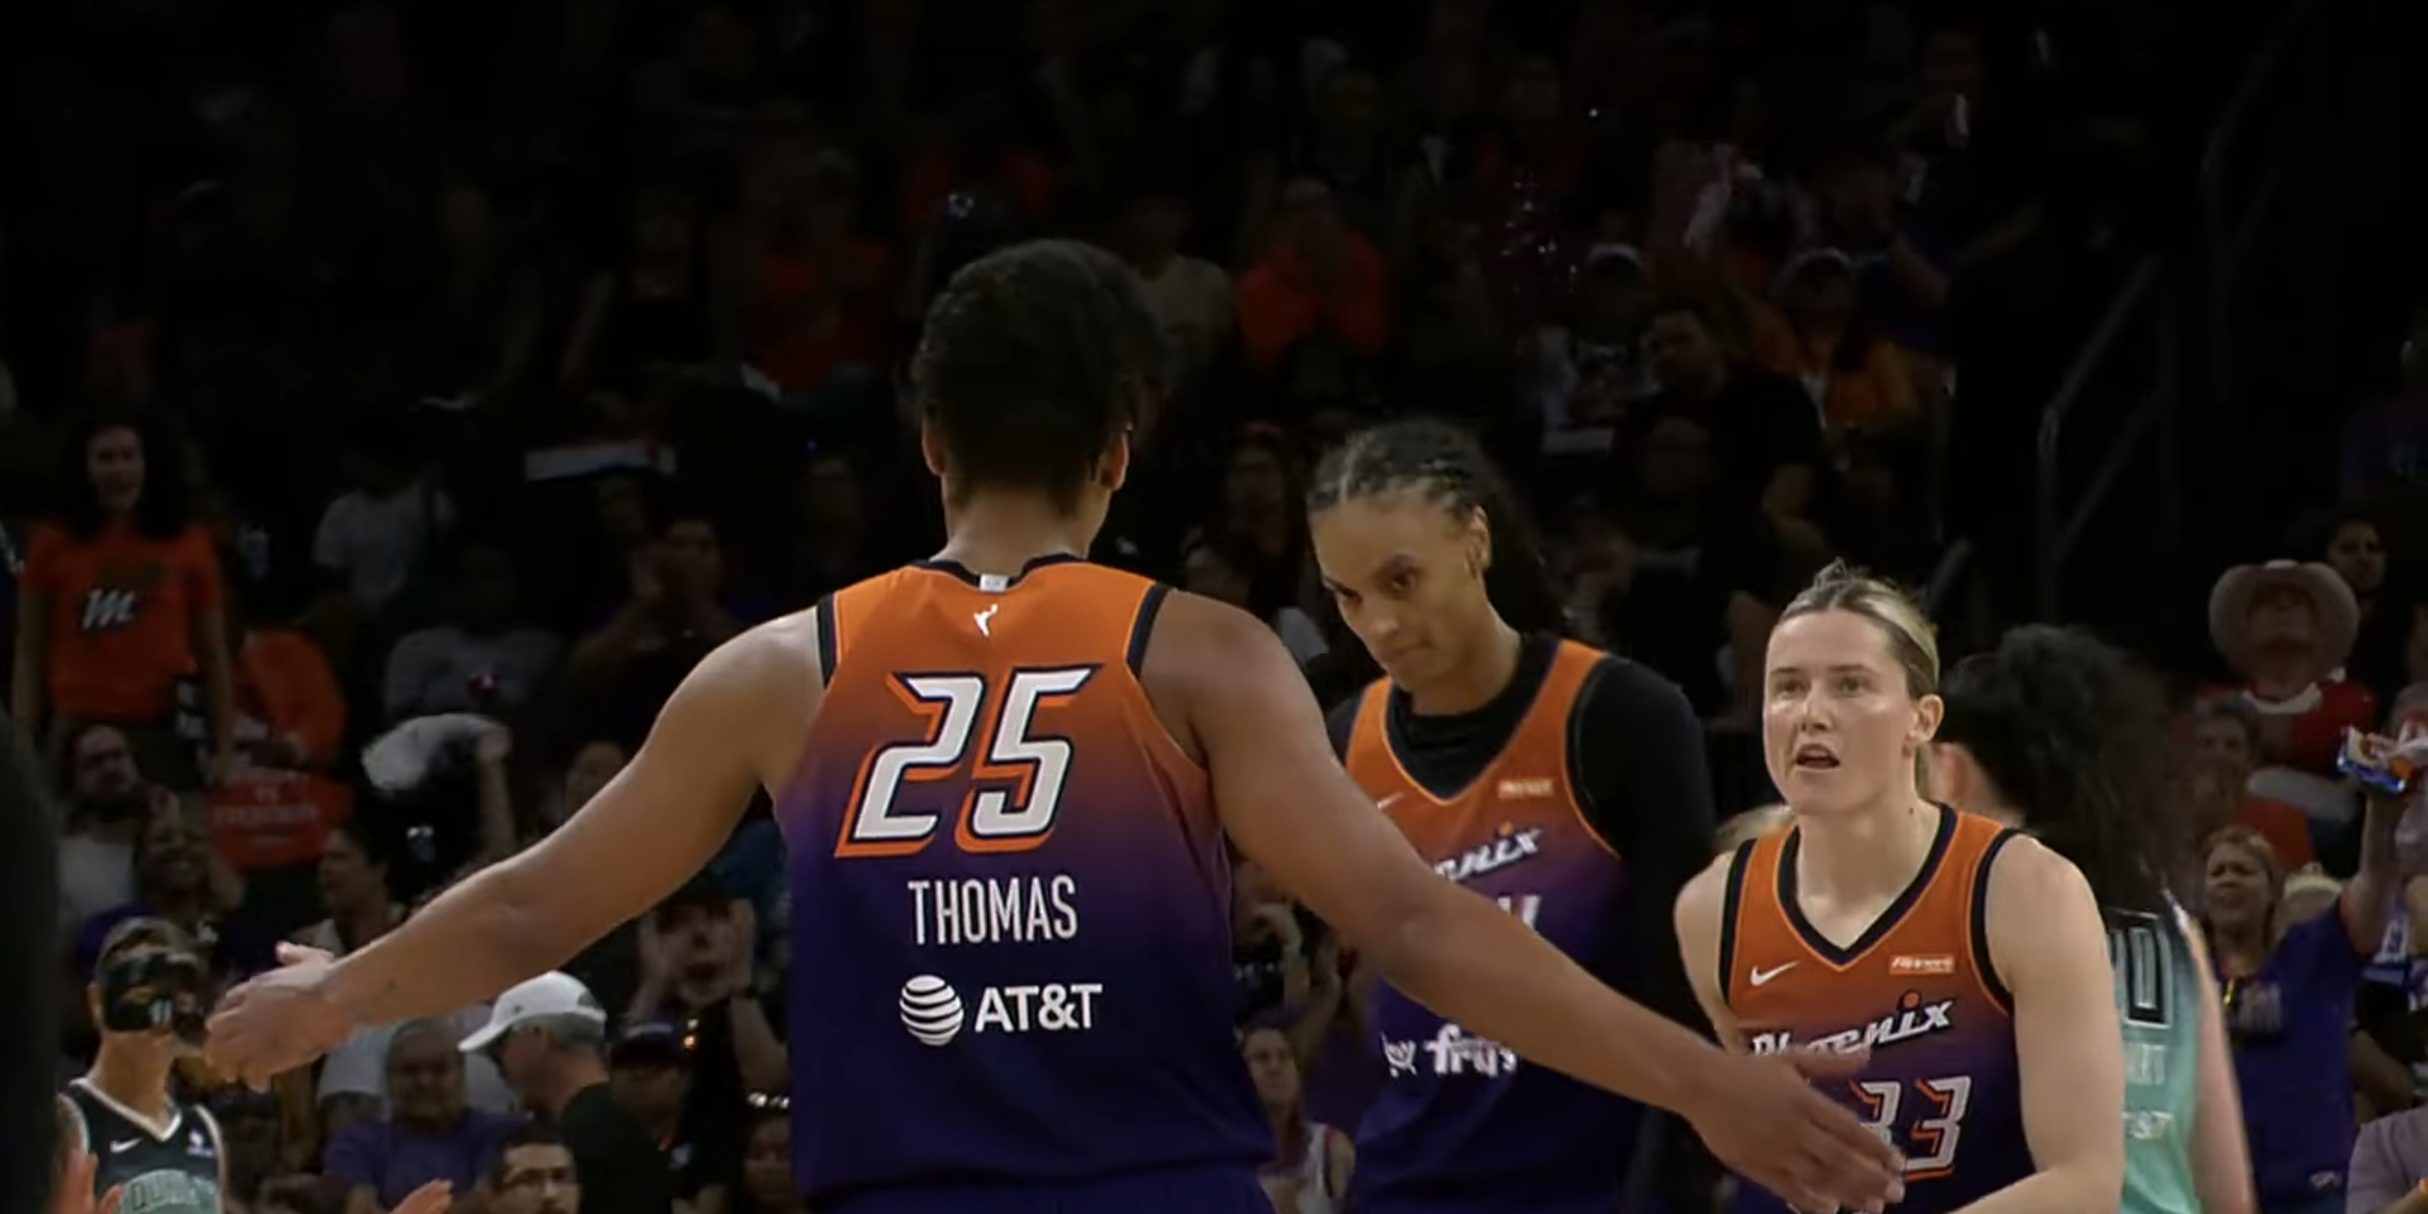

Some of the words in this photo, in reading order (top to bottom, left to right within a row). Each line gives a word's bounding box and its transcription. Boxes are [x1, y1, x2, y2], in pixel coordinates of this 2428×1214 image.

[834, 664, 1102, 858] 25
[907, 873, 1079, 946] THOMAS
[974, 982, 1103, 1034] AT&T
